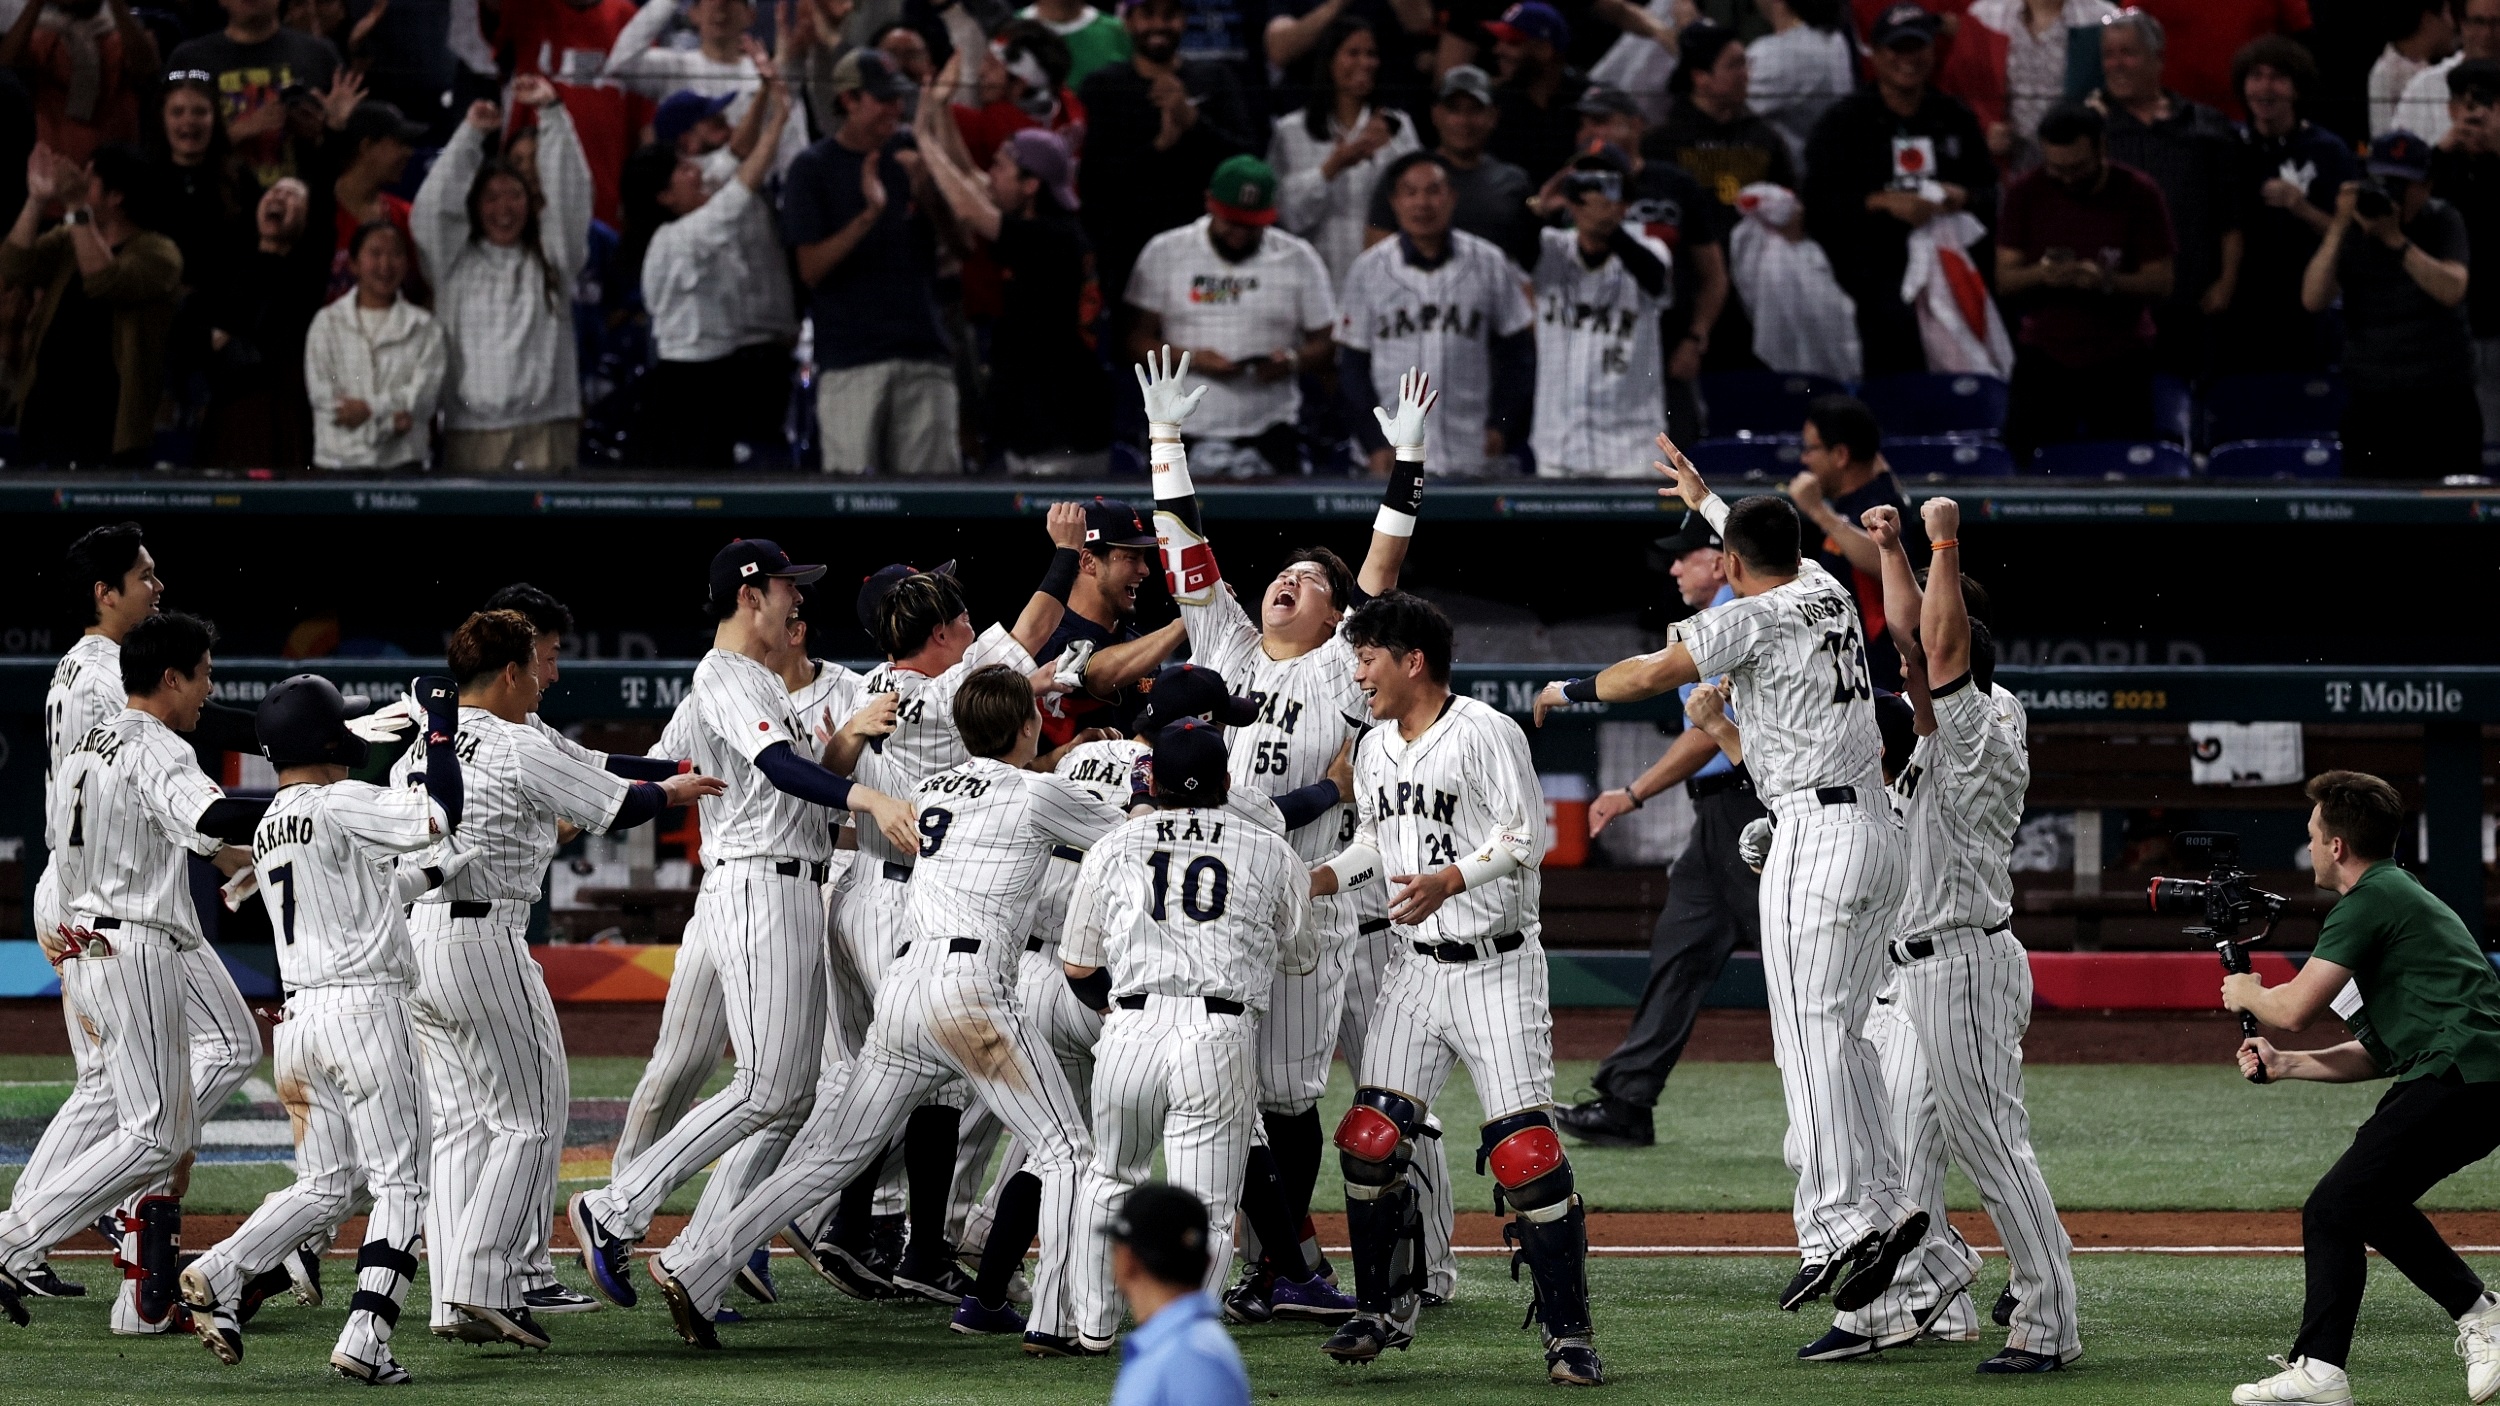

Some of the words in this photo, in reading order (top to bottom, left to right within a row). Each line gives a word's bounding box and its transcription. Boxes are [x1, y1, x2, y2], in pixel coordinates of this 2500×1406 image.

[1377, 303, 1483, 338] JAPAN
[1152, 463, 1170, 474] APAN
[1413, 490, 1422, 499] 55
[1821, 627, 1870, 703] 23
[1227, 683, 1303, 735] PAN
[2014, 690, 2109, 710] CLASSIC
[2112, 690, 2169, 710] 2023
[2360, 681, 2464, 713] Mobile
[1255, 741, 1288, 775] 55
[69, 769, 87, 846] 1
[1378, 781, 1458, 827] APAN
[918, 806, 953, 858] 9
[1156, 818, 1225, 844] KAI
[1425, 832, 1458, 866] 24
[1146, 849, 1229, 922] 10
[1348, 866, 1375, 887] JAPAN
[268, 861, 295, 946] 7
